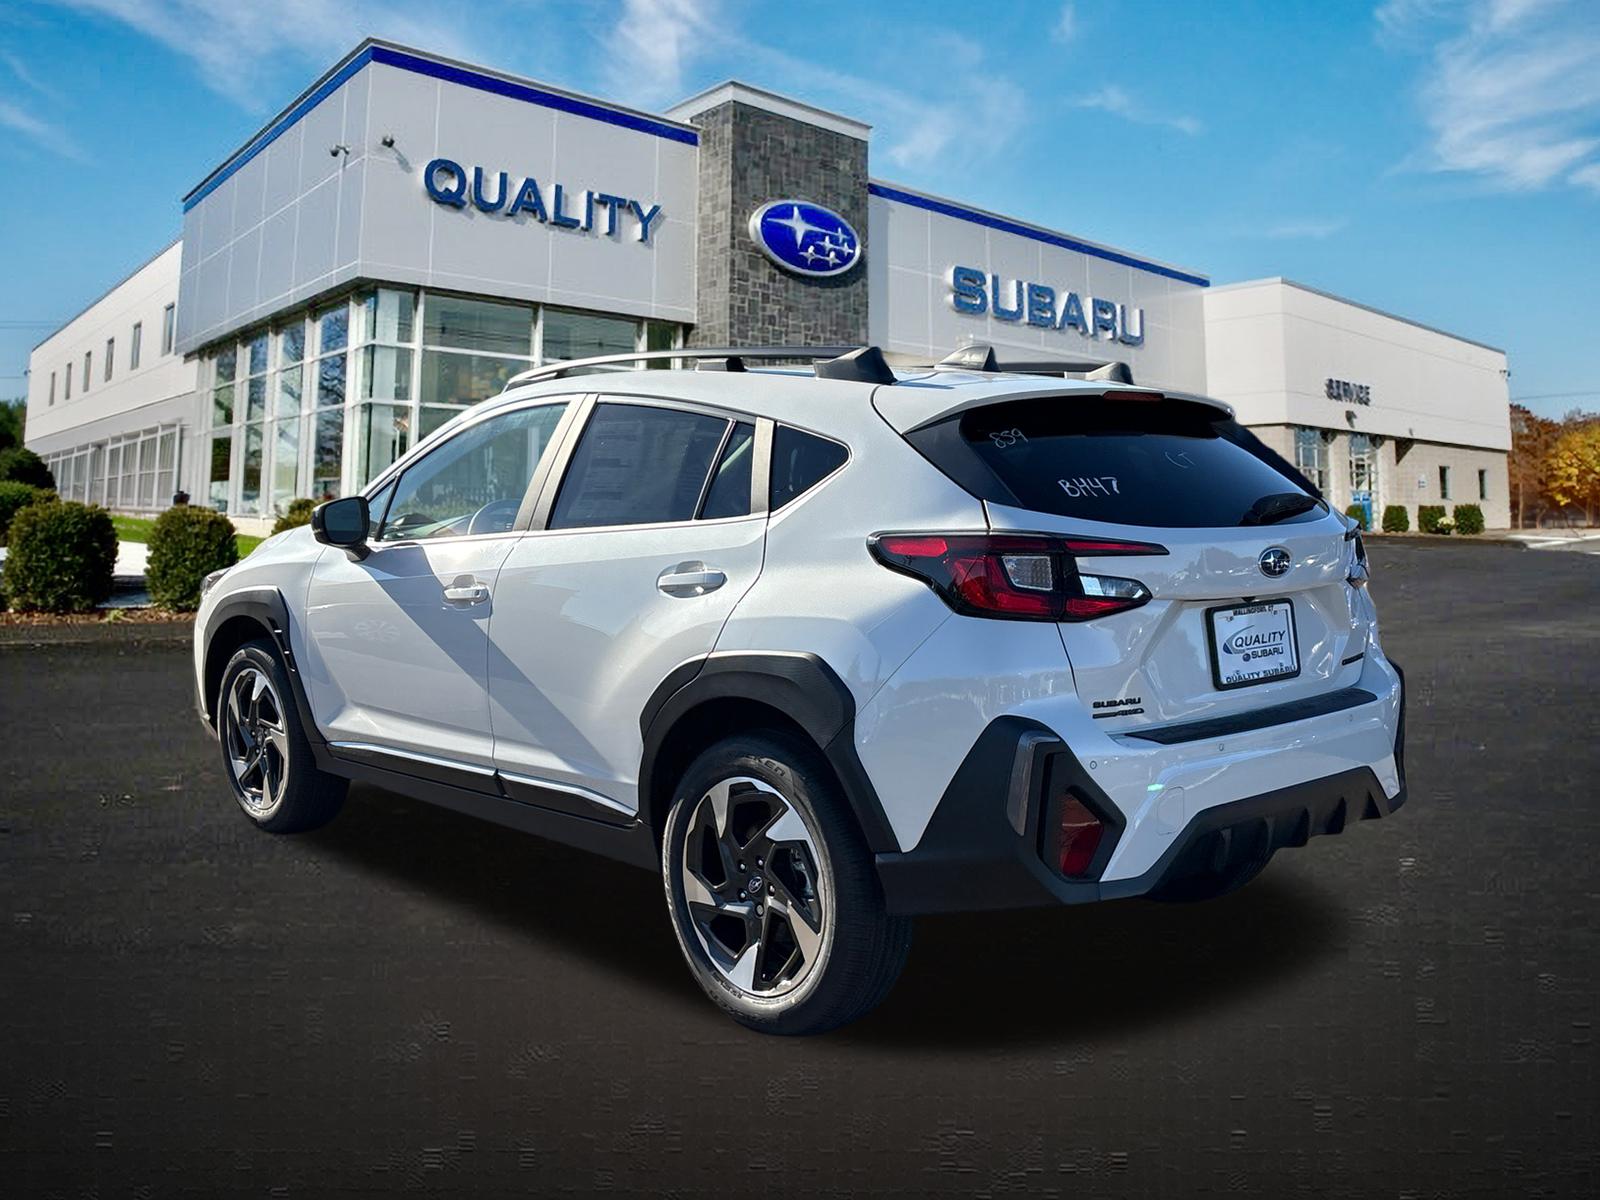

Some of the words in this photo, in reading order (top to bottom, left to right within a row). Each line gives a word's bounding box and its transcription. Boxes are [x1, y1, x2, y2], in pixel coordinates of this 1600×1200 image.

[424, 158, 661, 243] QUALITY
[951, 265, 1145, 347] SUBARU
[1325, 378, 1371, 407] SERVICE
[1057, 476, 1121, 498] BH47
[1234, 630, 1287, 648] QUALITY
[1251, 646, 1285, 659] SUBARU
[1225, 671, 1261, 684] QUALITY
[1263, 664, 1297, 677] SUBARU
[1092, 696, 1142, 709] SUBARU
